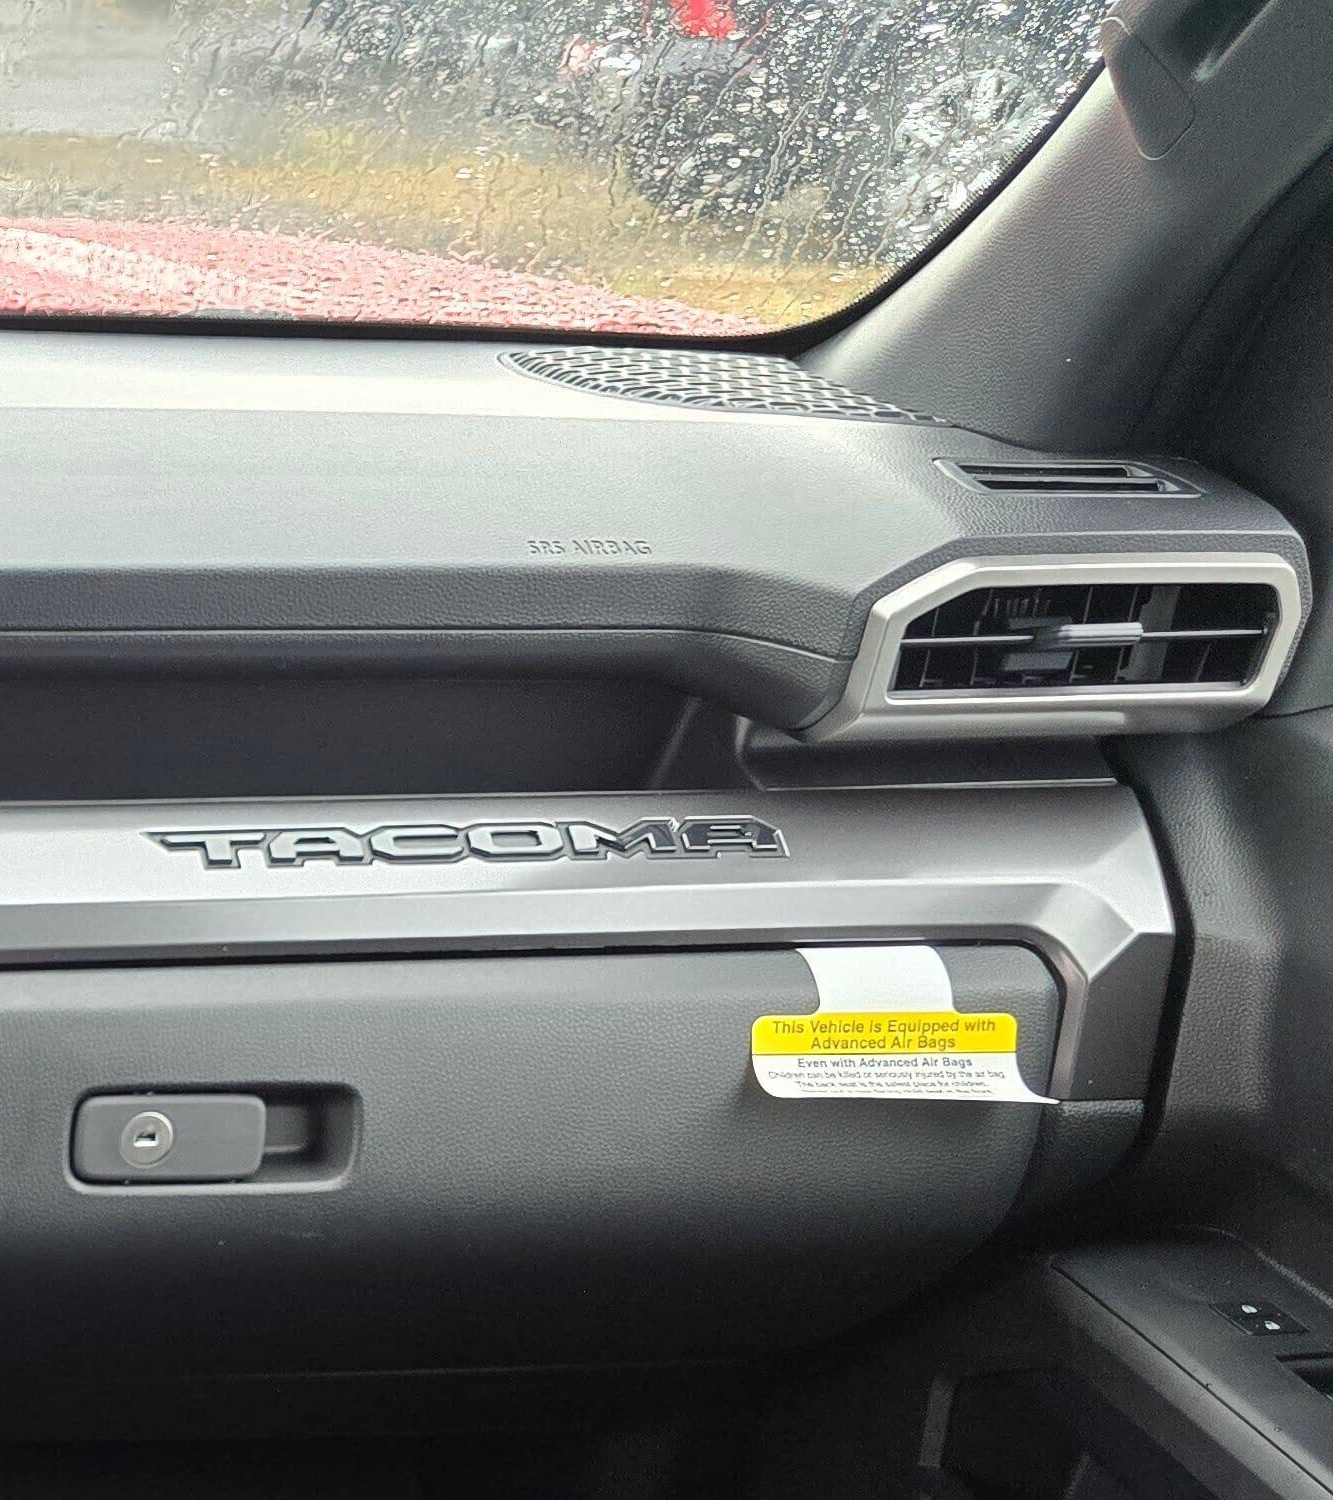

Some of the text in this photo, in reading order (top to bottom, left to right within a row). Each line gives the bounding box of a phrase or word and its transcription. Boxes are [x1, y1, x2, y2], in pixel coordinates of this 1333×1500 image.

[526, 539, 653, 555] SRS AIRBAG
[139, 815, 793, 869] TACOMA
[773, 1019, 996, 1037] This Vehicle is Equipped with
[811, 1035, 957, 1051] Advanced Air Bags
[797, 1057, 973, 1069] Even with Advanced Air Bags
